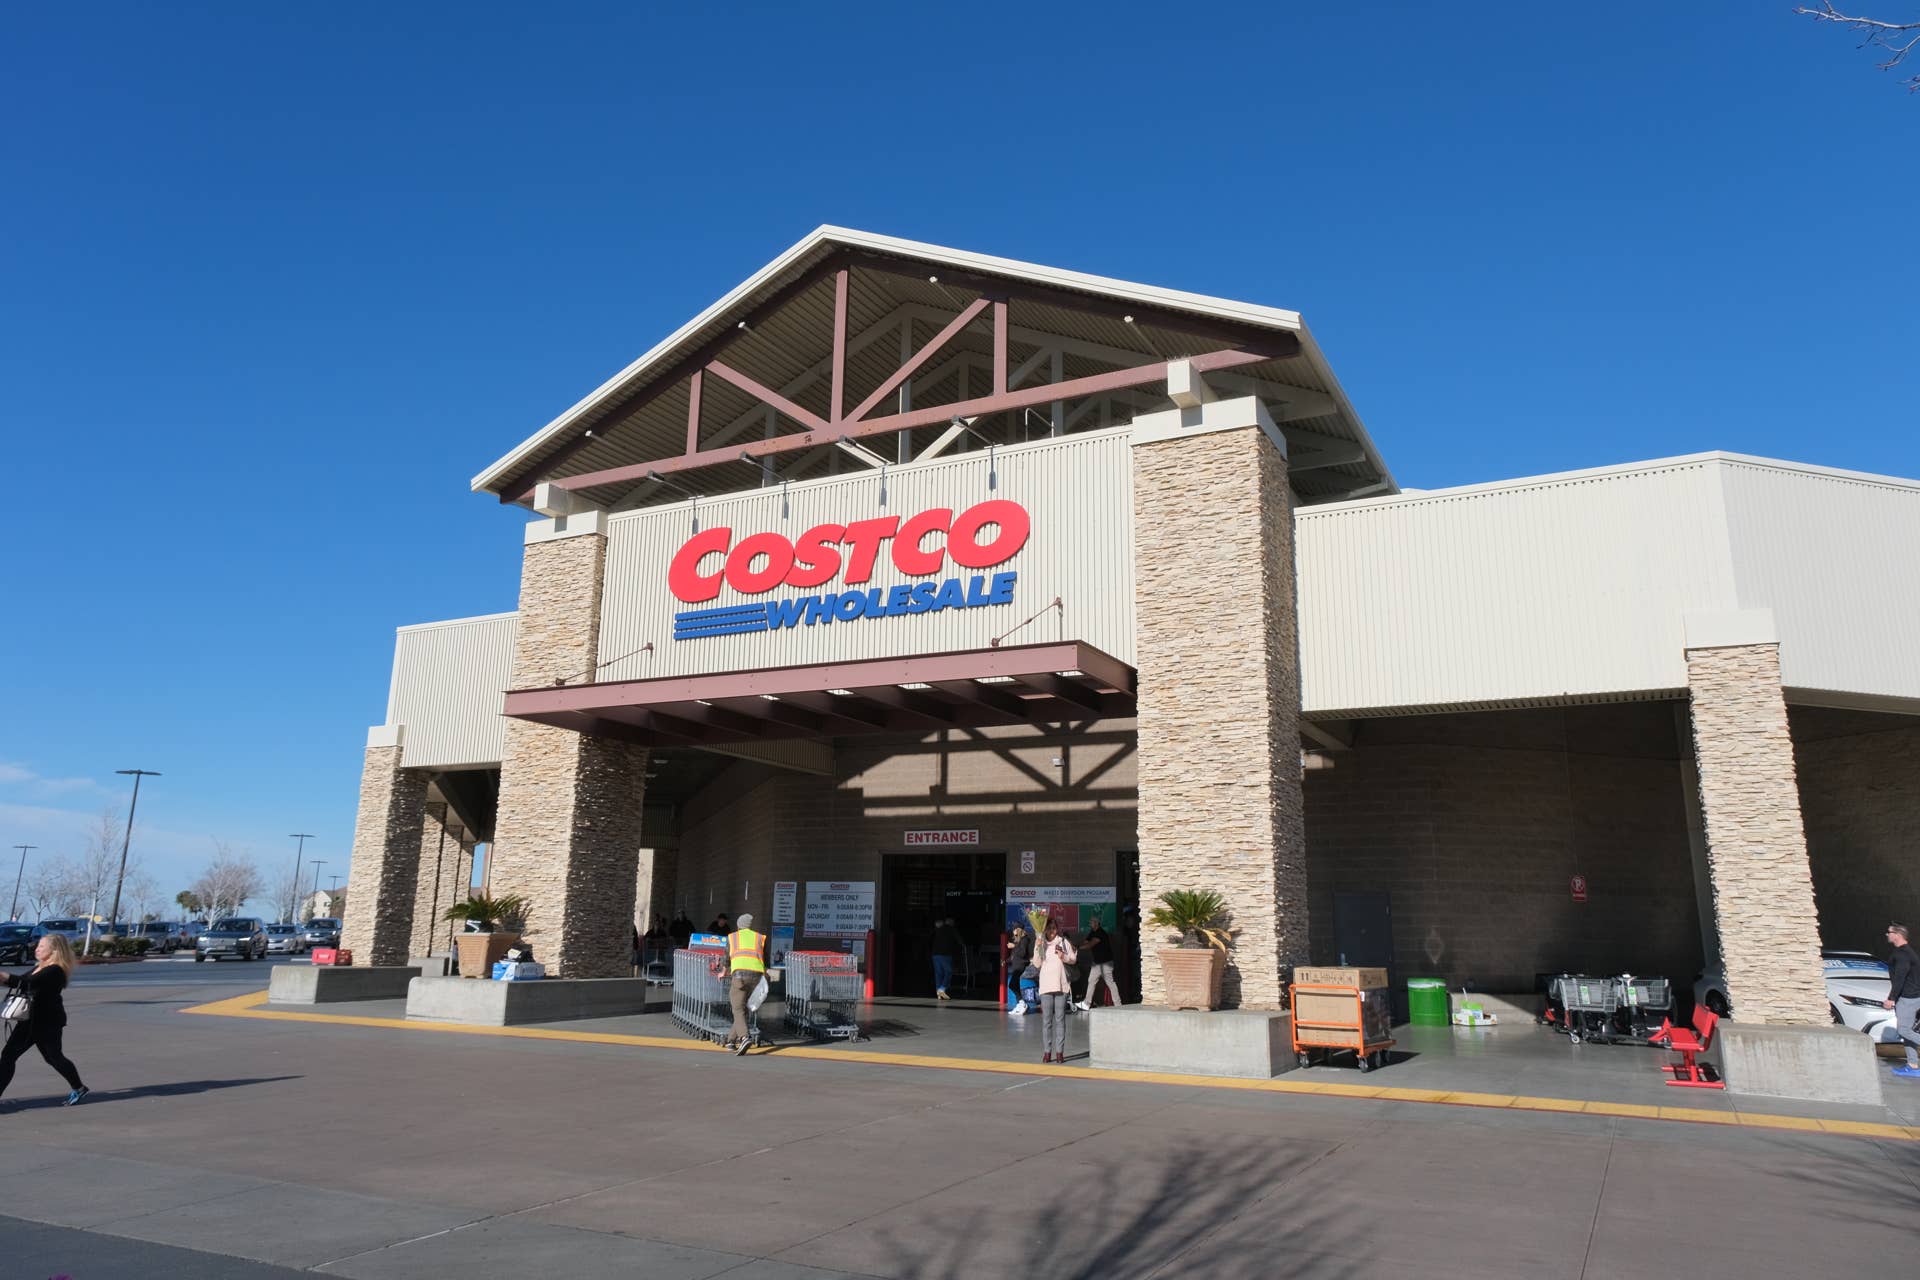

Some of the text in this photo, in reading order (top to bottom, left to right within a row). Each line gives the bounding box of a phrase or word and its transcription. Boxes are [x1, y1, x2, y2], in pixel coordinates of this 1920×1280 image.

[668, 499, 1030, 603] COSTCO
[765, 570, 1017, 630] WHOLESALE
[906, 832, 977, 843] ENTRANCE
